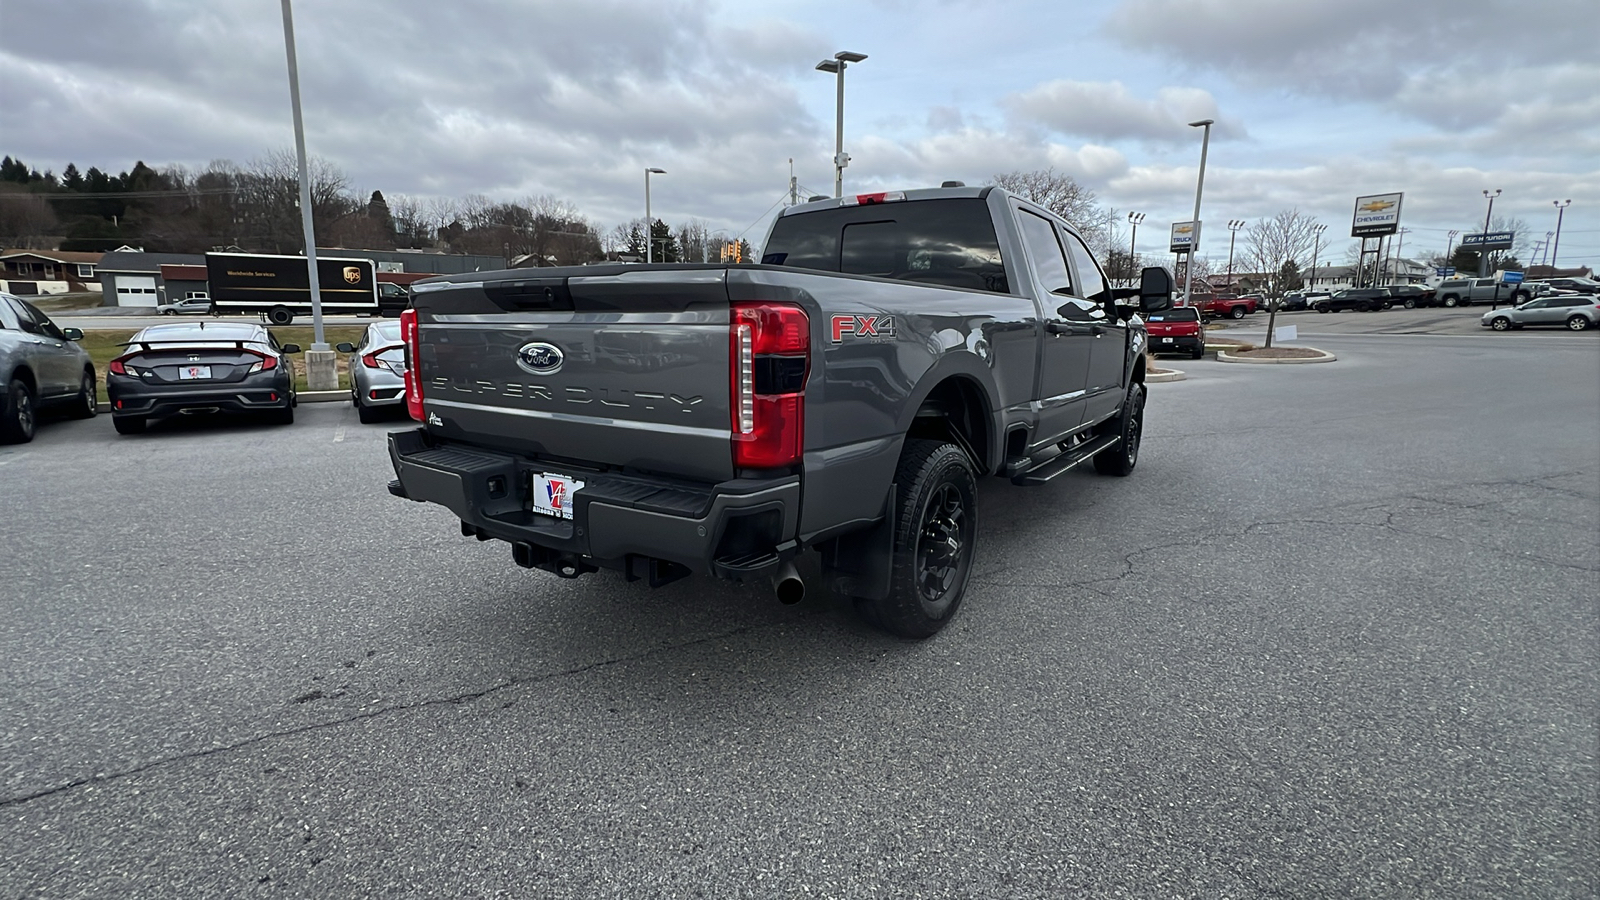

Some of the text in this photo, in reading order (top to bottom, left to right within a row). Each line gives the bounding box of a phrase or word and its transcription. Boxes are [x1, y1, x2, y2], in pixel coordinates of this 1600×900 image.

[1356, 214, 1395, 223] CHEVROLET
[345, 271, 360, 282] ups
[830, 313, 897, 345] FX4
[526, 347, 551, 365] Ford
[431, 377, 704, 413] SUPER DUTY
